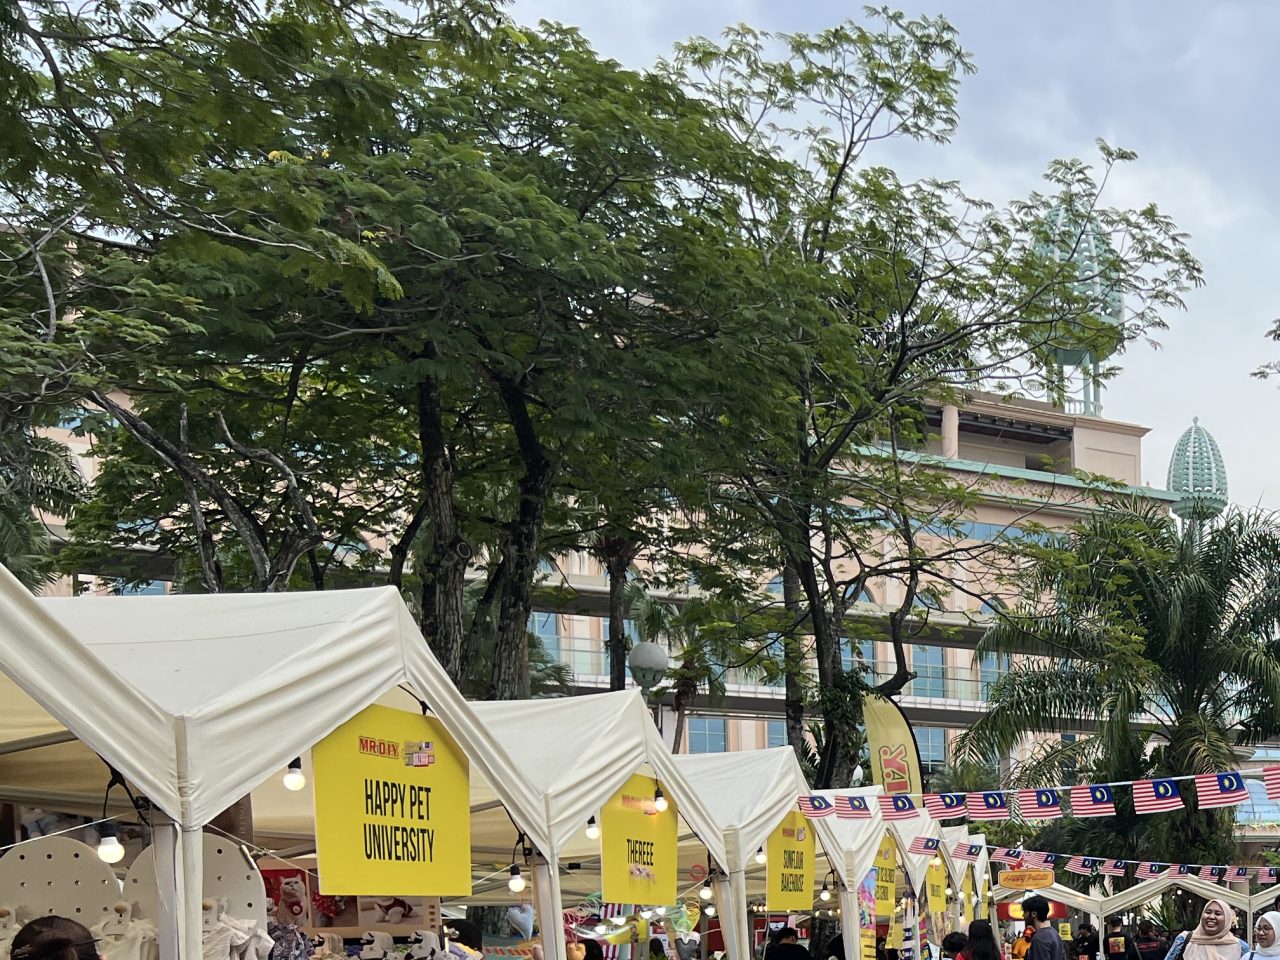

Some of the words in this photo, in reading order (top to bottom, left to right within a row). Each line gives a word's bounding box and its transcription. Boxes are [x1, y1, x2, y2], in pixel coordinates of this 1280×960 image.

[364, 778, 406, 818] HAPPY
[409, 785, 431, 821] PET
[364, 823, 434, 863] UNIVERSITY
[626, 839, 654, 866] THEREEE
